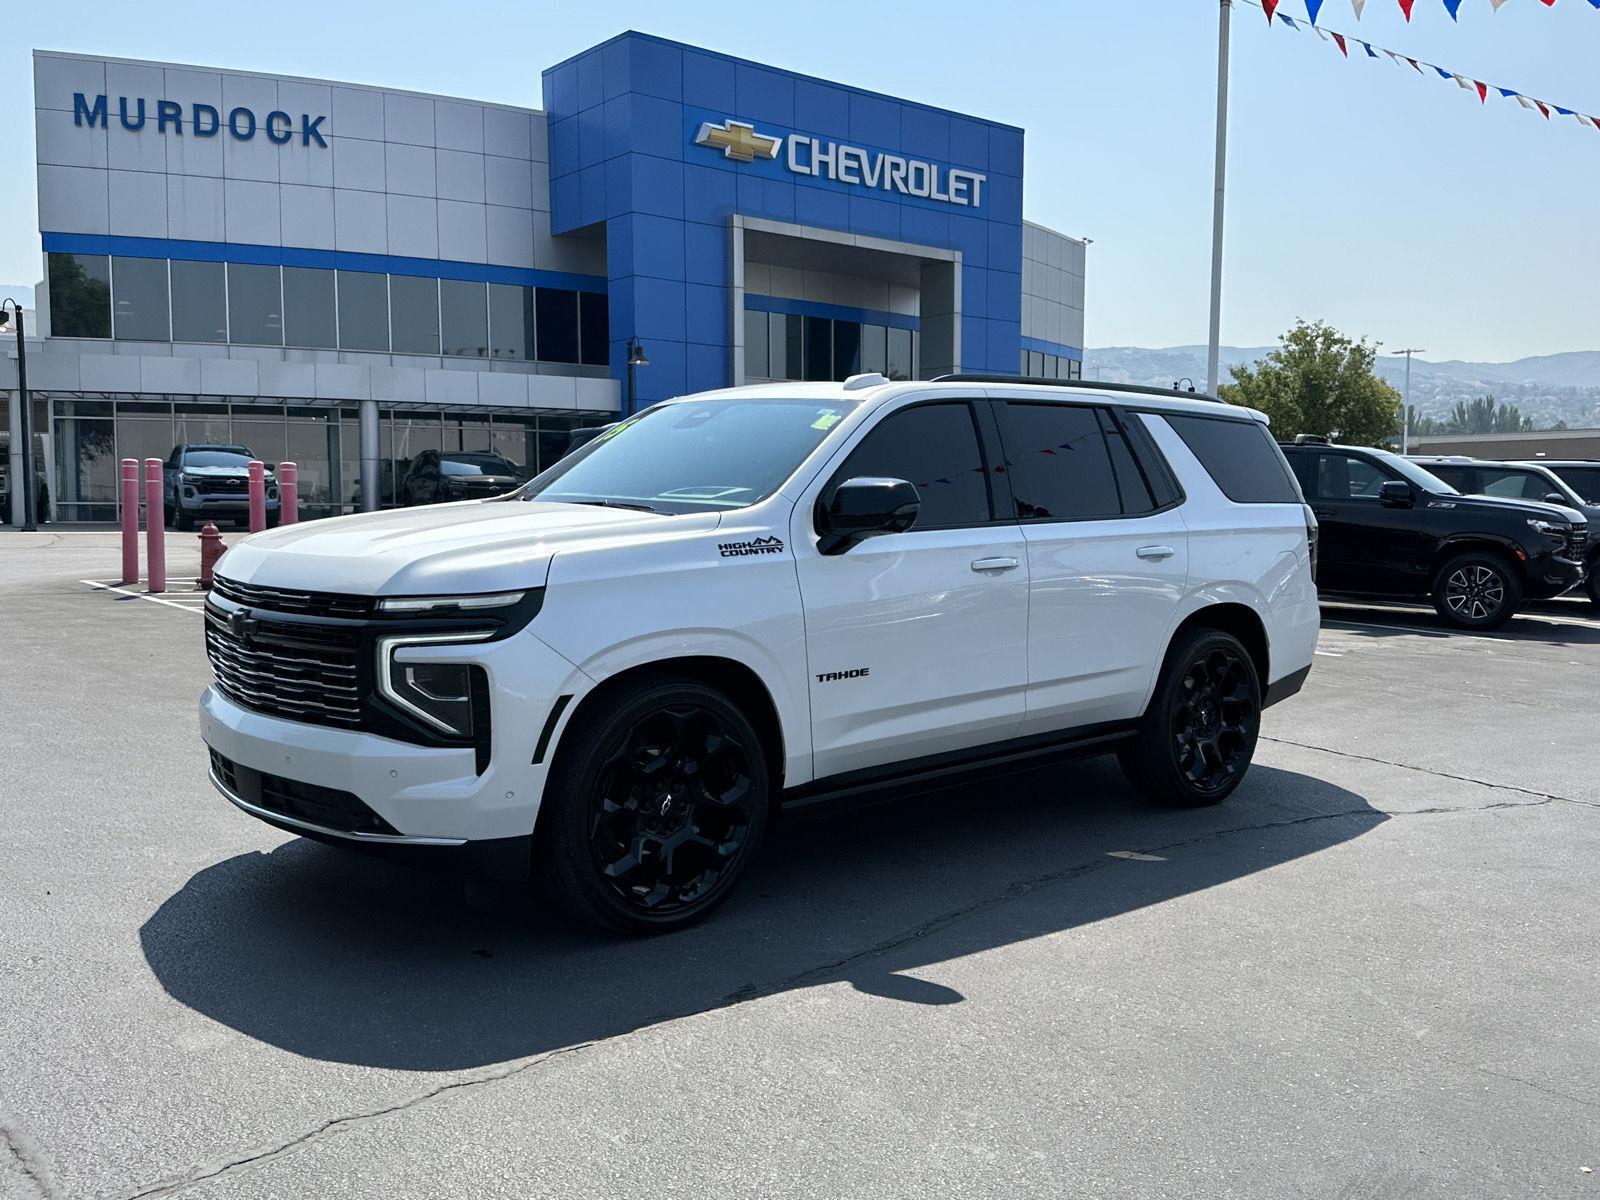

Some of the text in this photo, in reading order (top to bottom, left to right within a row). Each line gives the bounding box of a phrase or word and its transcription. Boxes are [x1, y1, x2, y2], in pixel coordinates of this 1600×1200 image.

[73, 92, 328, 148] MURDOCK
[787, 134, 986, 207] CHEVROLET
[718, 541, 752, 551] HIGH
[720, 546, 784, 557] COUNTRY
[815, 667, 870, 682] TAHOE
